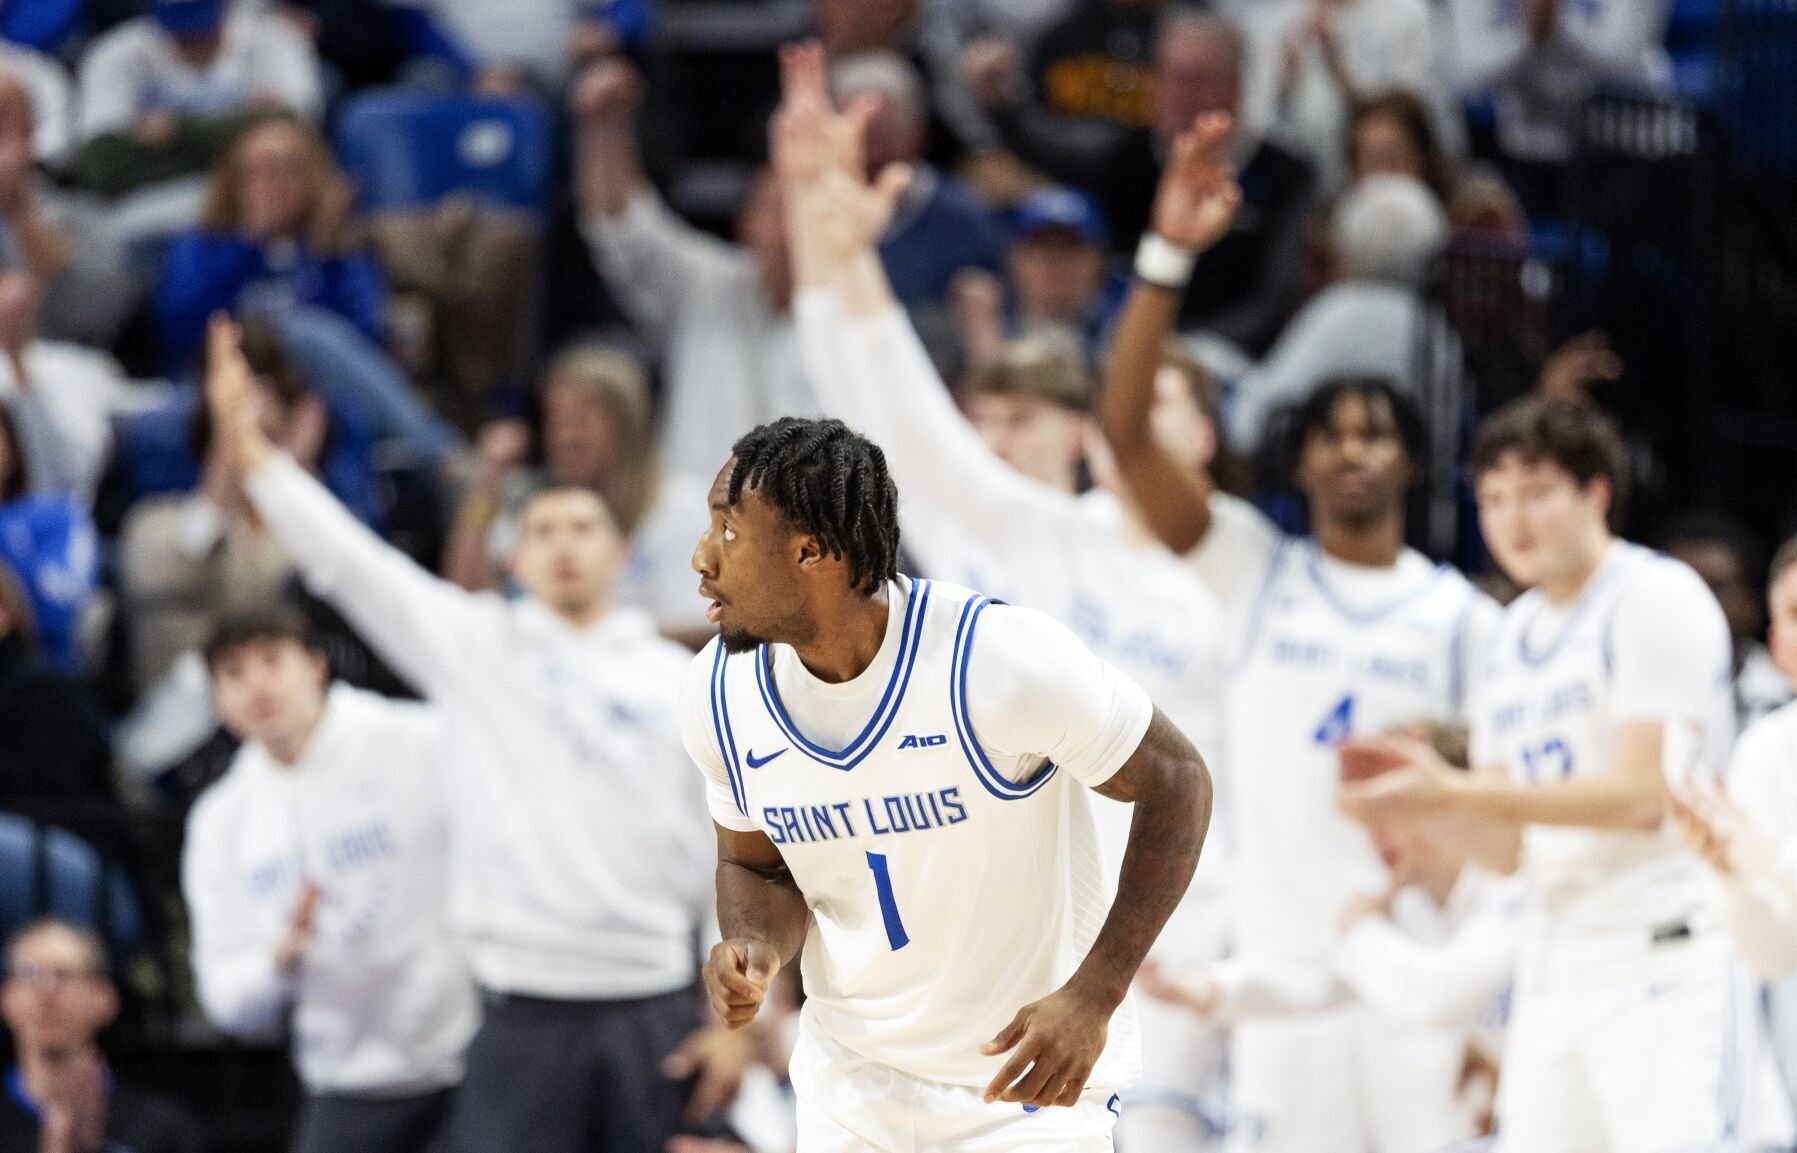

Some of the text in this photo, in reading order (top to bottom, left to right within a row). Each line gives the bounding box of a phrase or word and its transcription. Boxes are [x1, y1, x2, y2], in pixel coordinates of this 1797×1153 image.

[897, 734, 947, 750] A10
[763, 785, 969, 844] SAINT LOUIS
[865, 850, 910, 951] 1
